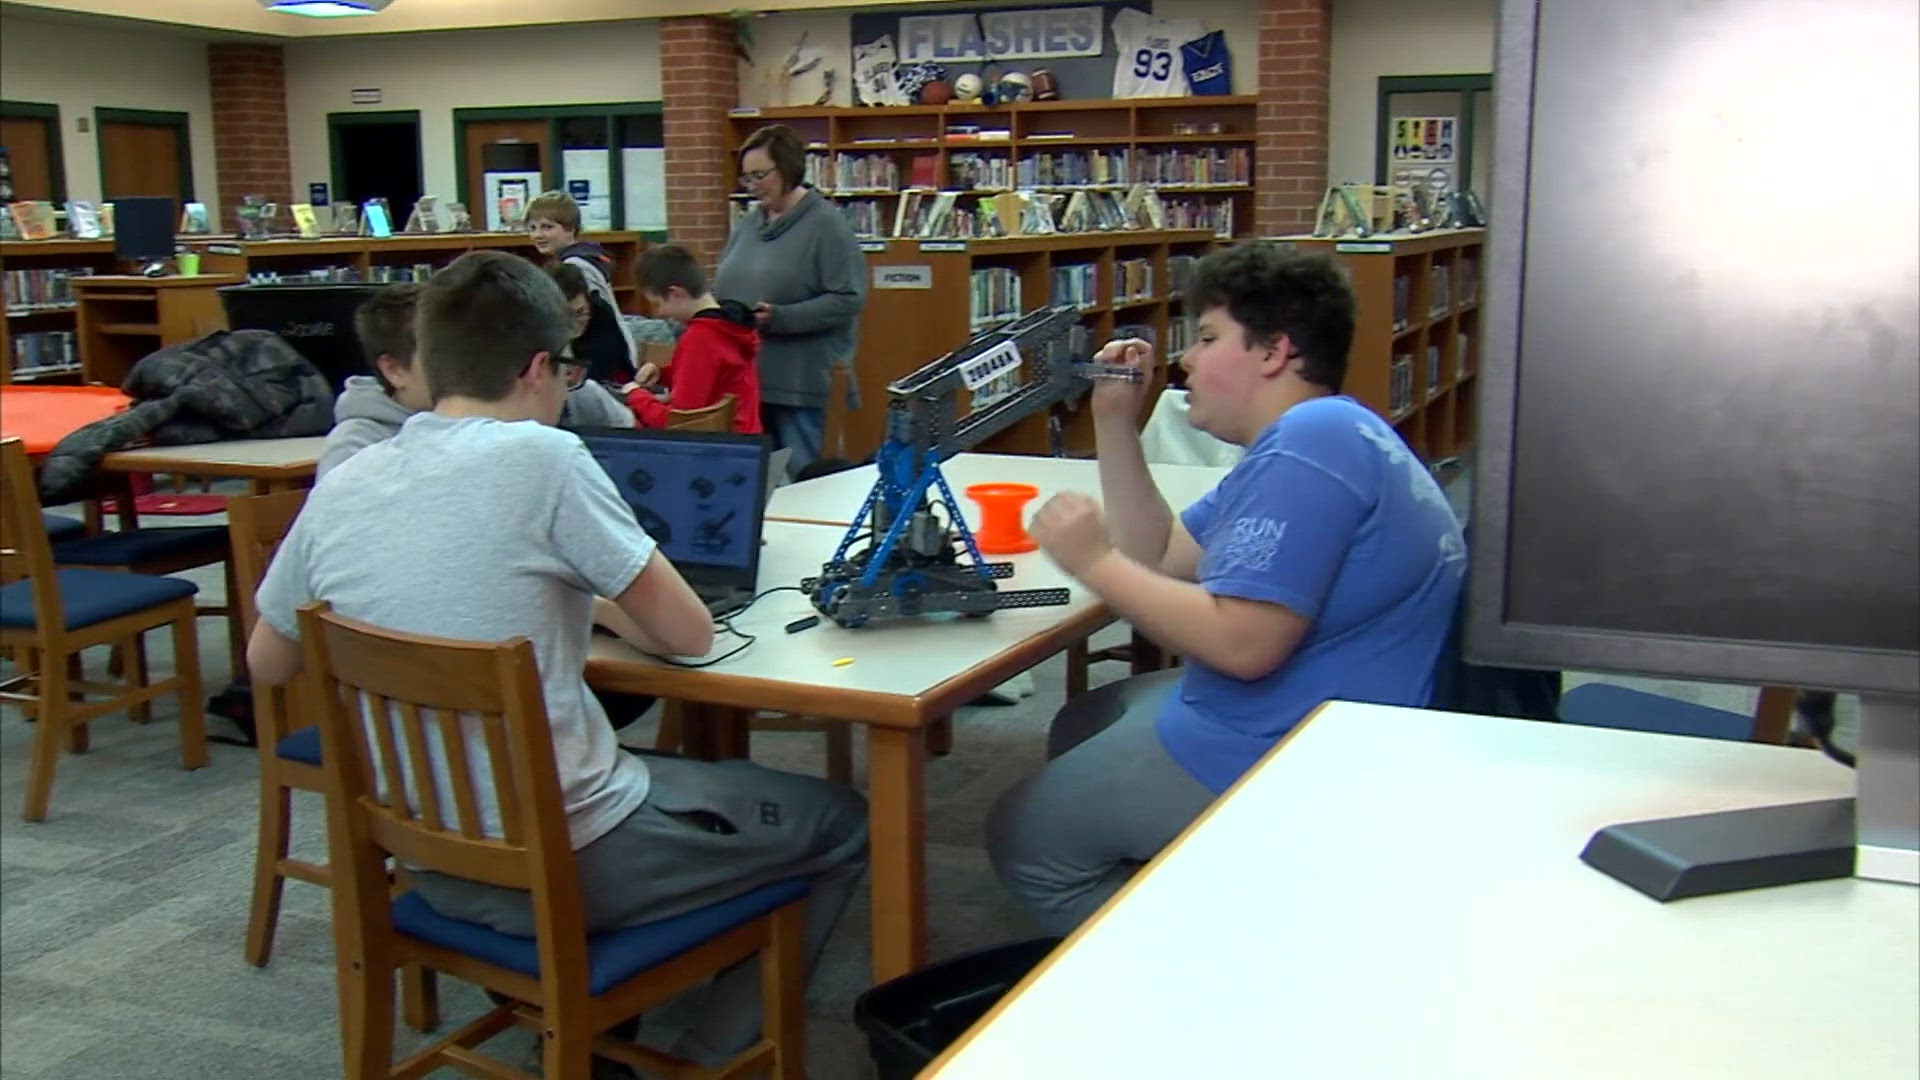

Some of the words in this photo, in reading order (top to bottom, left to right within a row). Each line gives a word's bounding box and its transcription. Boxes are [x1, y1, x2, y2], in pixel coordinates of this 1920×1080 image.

[908, 16, 1095, 59] FLASHES
[1134, 48, 1172, 81] 93
[1396, 119, 1454, 139] STEM
[1233, 517, 1287, 540] RUN
